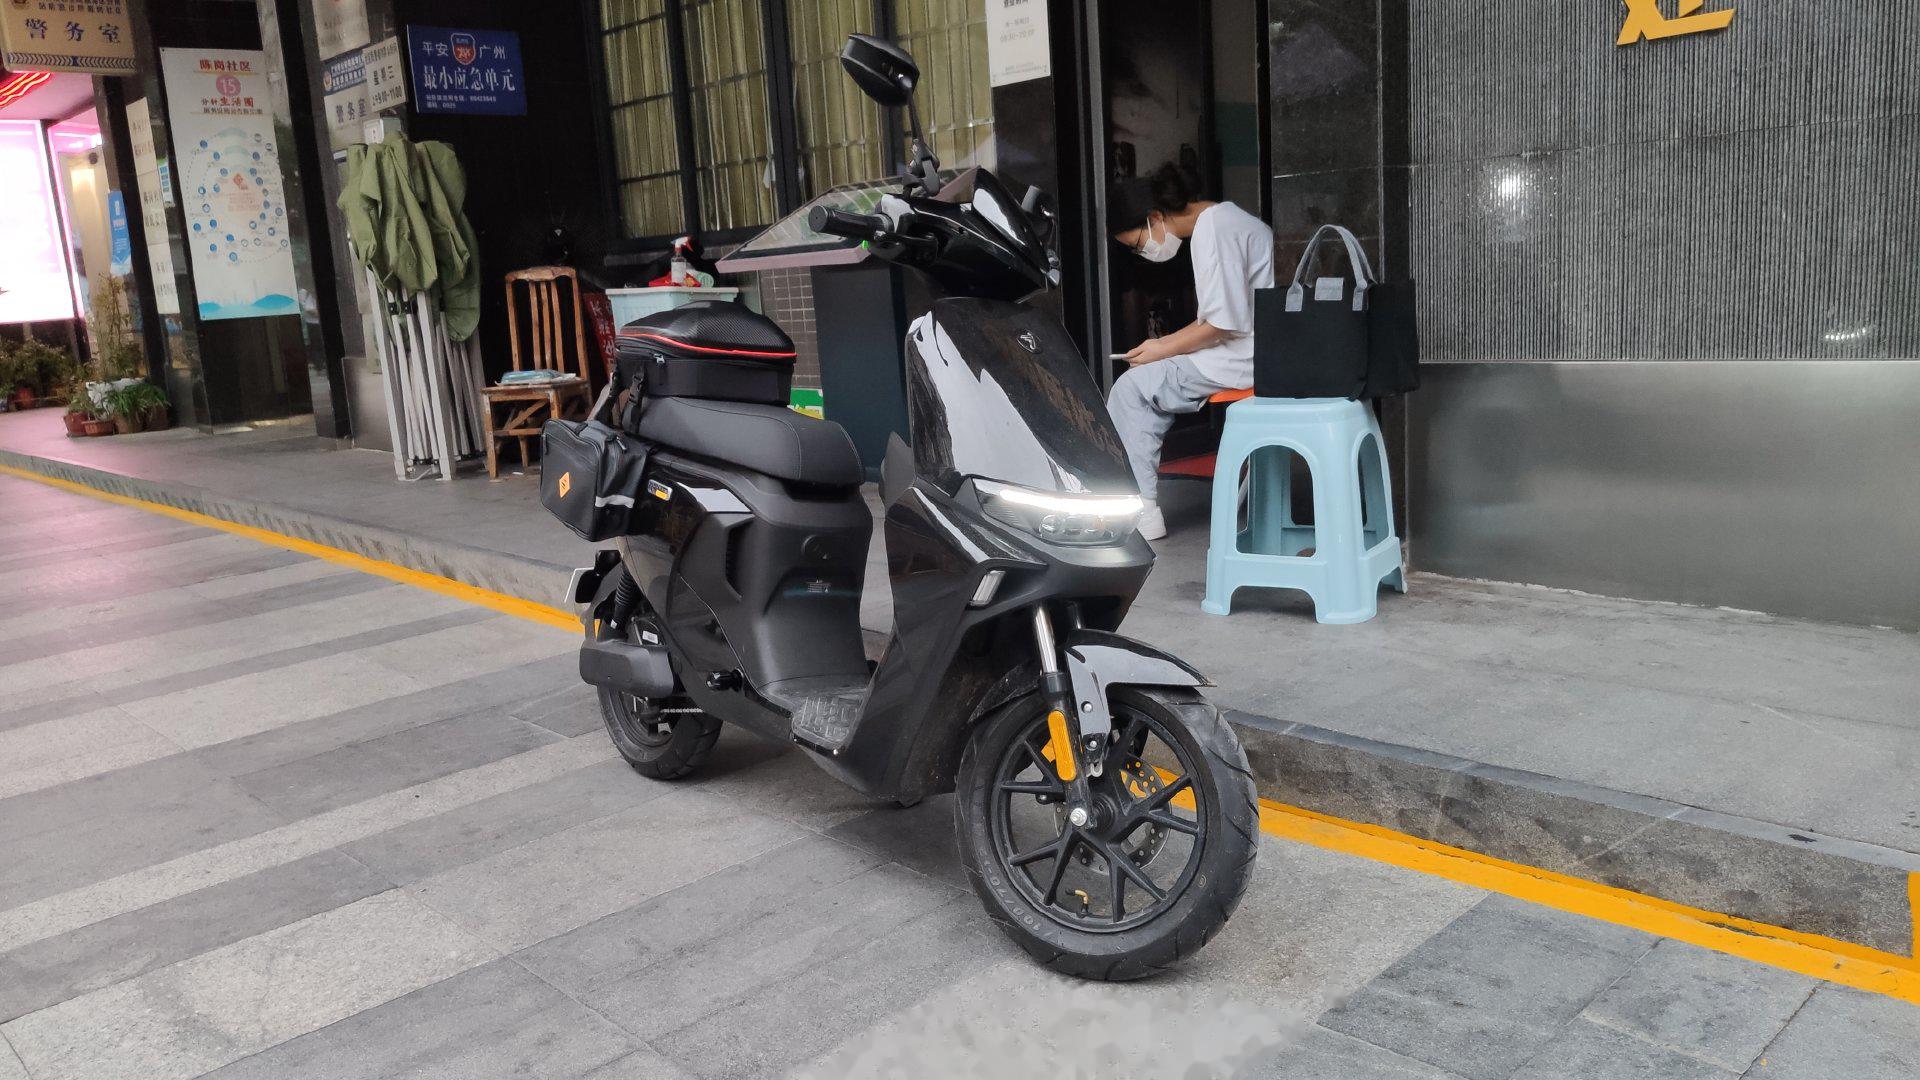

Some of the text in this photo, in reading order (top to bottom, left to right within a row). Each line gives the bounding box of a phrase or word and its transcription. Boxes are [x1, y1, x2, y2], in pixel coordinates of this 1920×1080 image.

[25, 19, 120, 43] 警务室
[422, 41, 449, 57] 平安
[480, 44, 506, 59] 广州
[200, 59, 252, 72] 陈岗社区
[221, 79, 236, 93] 15
[424, 65, 516, 92] 最小应急单元
[336, 98, 367, 125] 警务室
